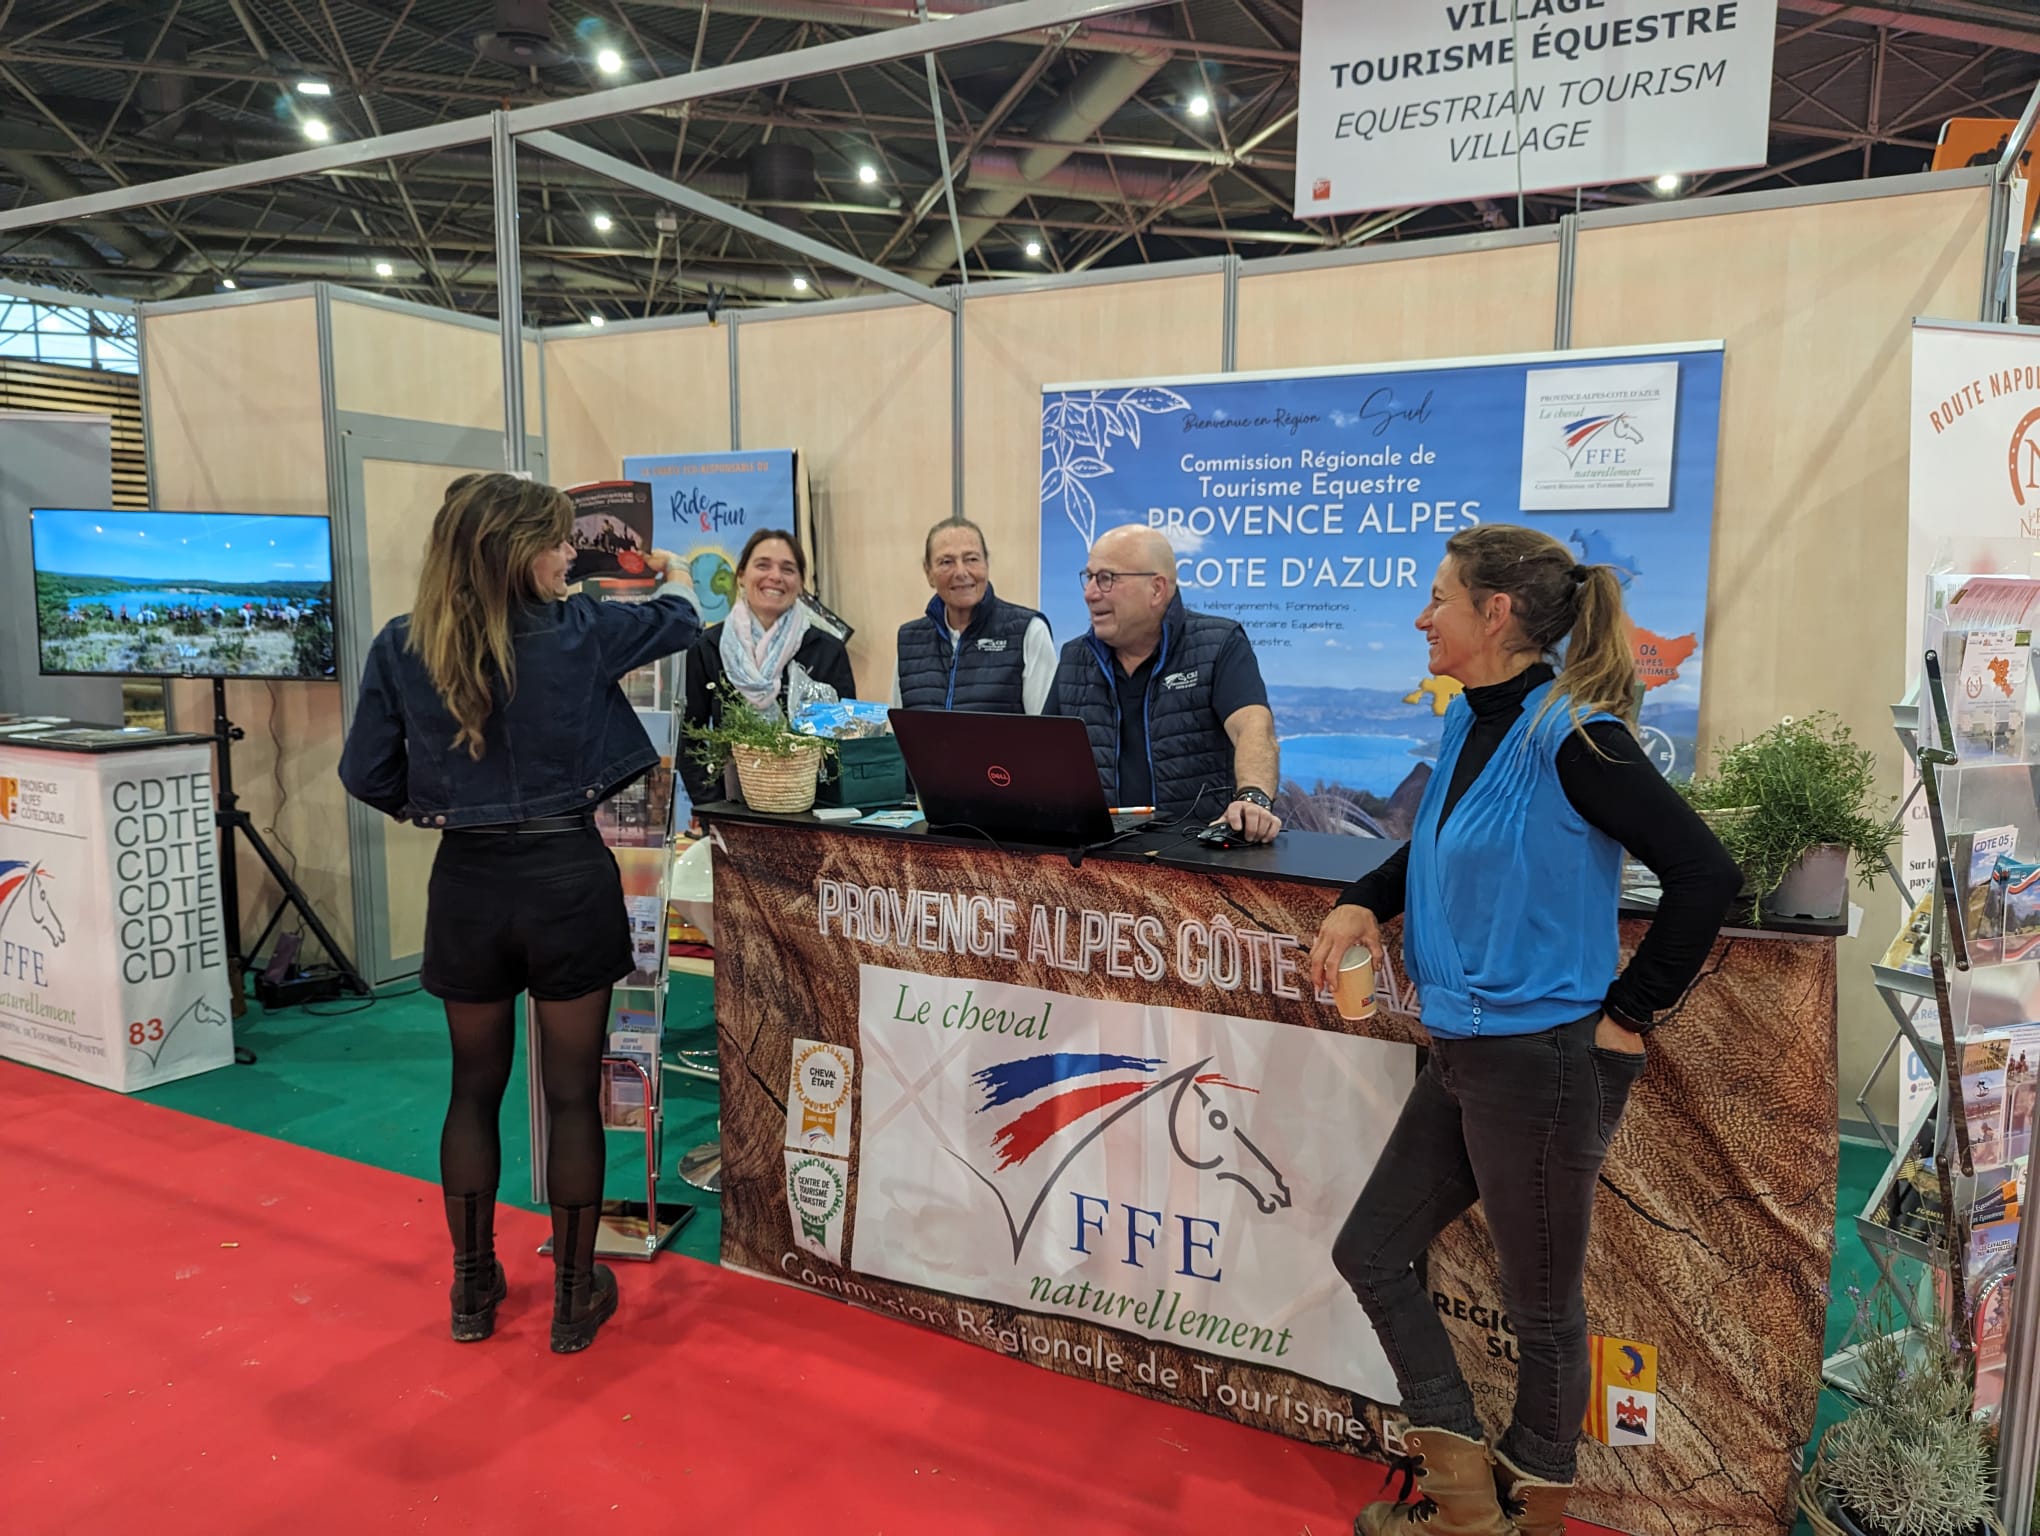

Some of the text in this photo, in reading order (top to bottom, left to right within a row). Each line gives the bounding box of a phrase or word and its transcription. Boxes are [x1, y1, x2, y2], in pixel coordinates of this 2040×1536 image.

[1331, 2, 1738, 88] TOURISME ÉQUESTRE
[1335, 59, 1727, 140] EQUESTRIAN TOURISM
[1448, 120, 1592, 163] VILLAGE
[1359, 386, 1435, 437] Sud
[1553, 406, 1586, 419] cheval
[1929, 365, 2040, 434] ROUTE NAPOL
[1182, 407, 1321, 436] Bienvenue en Région
[1180, 443, 1436, 473] Commission Régionale de
[1573, 466, 1642, 478] naturellement
[1585, 448, 1627, 465] FFE
[1199, 472, 1421, 500] Tourisme Equestre
[670, 486, 709, 524] Ride
[709, 501, 747, 533] Fun
[1148, 501, 1481, 536] PROVENCE ALPES
[1174, 557, 1418, 588] COTE D'AZUR
[1286, 600, 1350, 612] Formations
[1640, 644, 1657, 656] 06
[20, 778, 57, 795] PROVENCE
[113, 772, 210, 813] CDTE
[115, 806, 212, 847] CDTE
[1975, 837, 1997, 853] CDTE
[1998, 835, 2010, 847] 05
[117, 839, 214, 881] CDTE
[1909, 861, 1926, 871] Sur
[119, 872, 216, 916] CDTE
[121, 905, 219, 950] CDTE
[818, 879, 1019, 962] PROVENCE
[1028, 904, 1164, 982] ALPES
[1176, 914, 1300, 998] CÔTE
[2, 940, 48, 987] FFE
[123, 937, 220, 984] CDTE
[0, 992, 76, 1025] aturellement
[893, 985, 1053, 1041] Le cheval
[129, 1018, 164, 1046] 83
[809, 1067, 837, 1080] CHEVAL
[811, 1076, 835, 1089] ÉTAPE
[798, 1175, 830, 1189] CENTRE DE
[1069, 1191, 1222, 1282] FFE
[1029, 1275, 1293, 1357] naturellement
[957, 1307, 1124, 1373] Régionale
[1138, 1351, 1179, 1389] de
[1194, 1364, 1366, 1440] Tourisme
